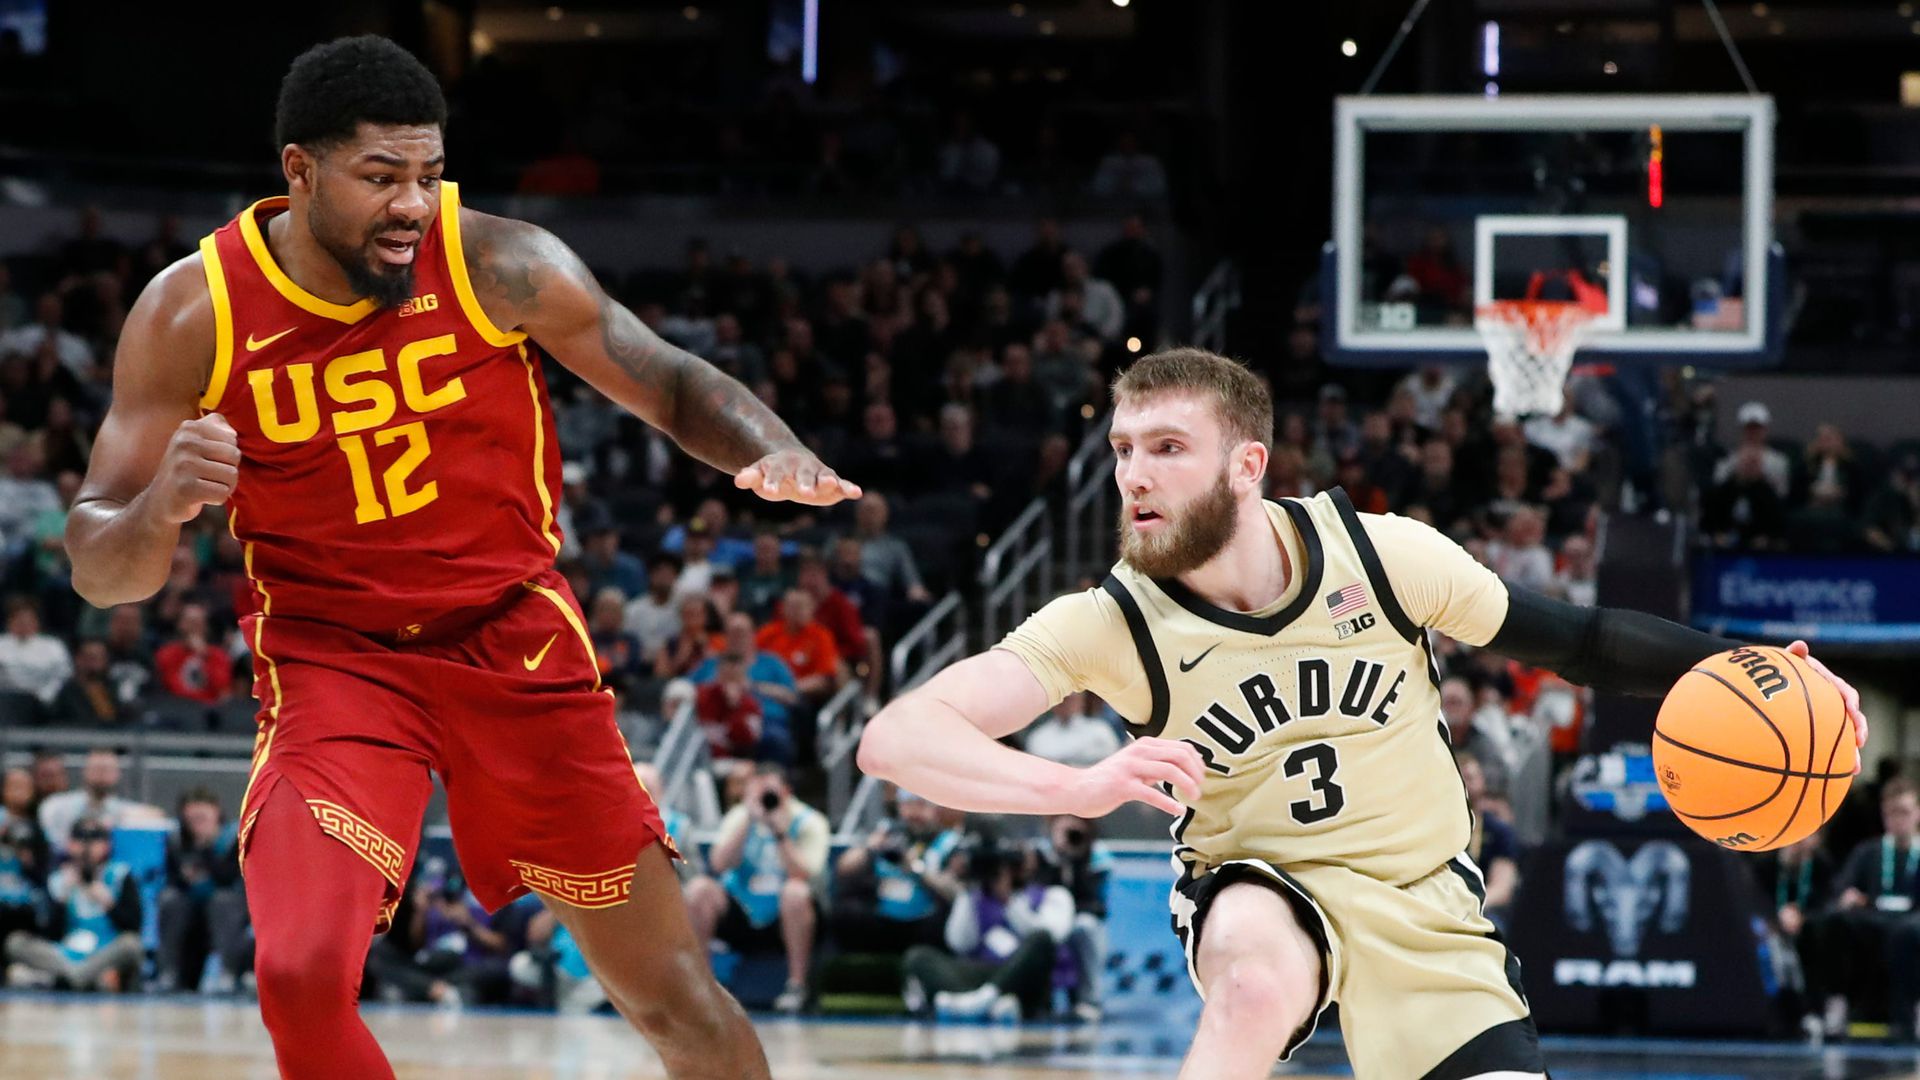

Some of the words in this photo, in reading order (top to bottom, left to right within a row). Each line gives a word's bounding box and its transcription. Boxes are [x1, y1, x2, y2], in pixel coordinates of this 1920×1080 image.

[247, 333, 467, 443] USC
[337, 421, 439, 524] 12
[1719, 571, 1876, 606] Elevance
[1282, 742, 1345, 825] 3
[1554, 958, 1697, 988] RAM
